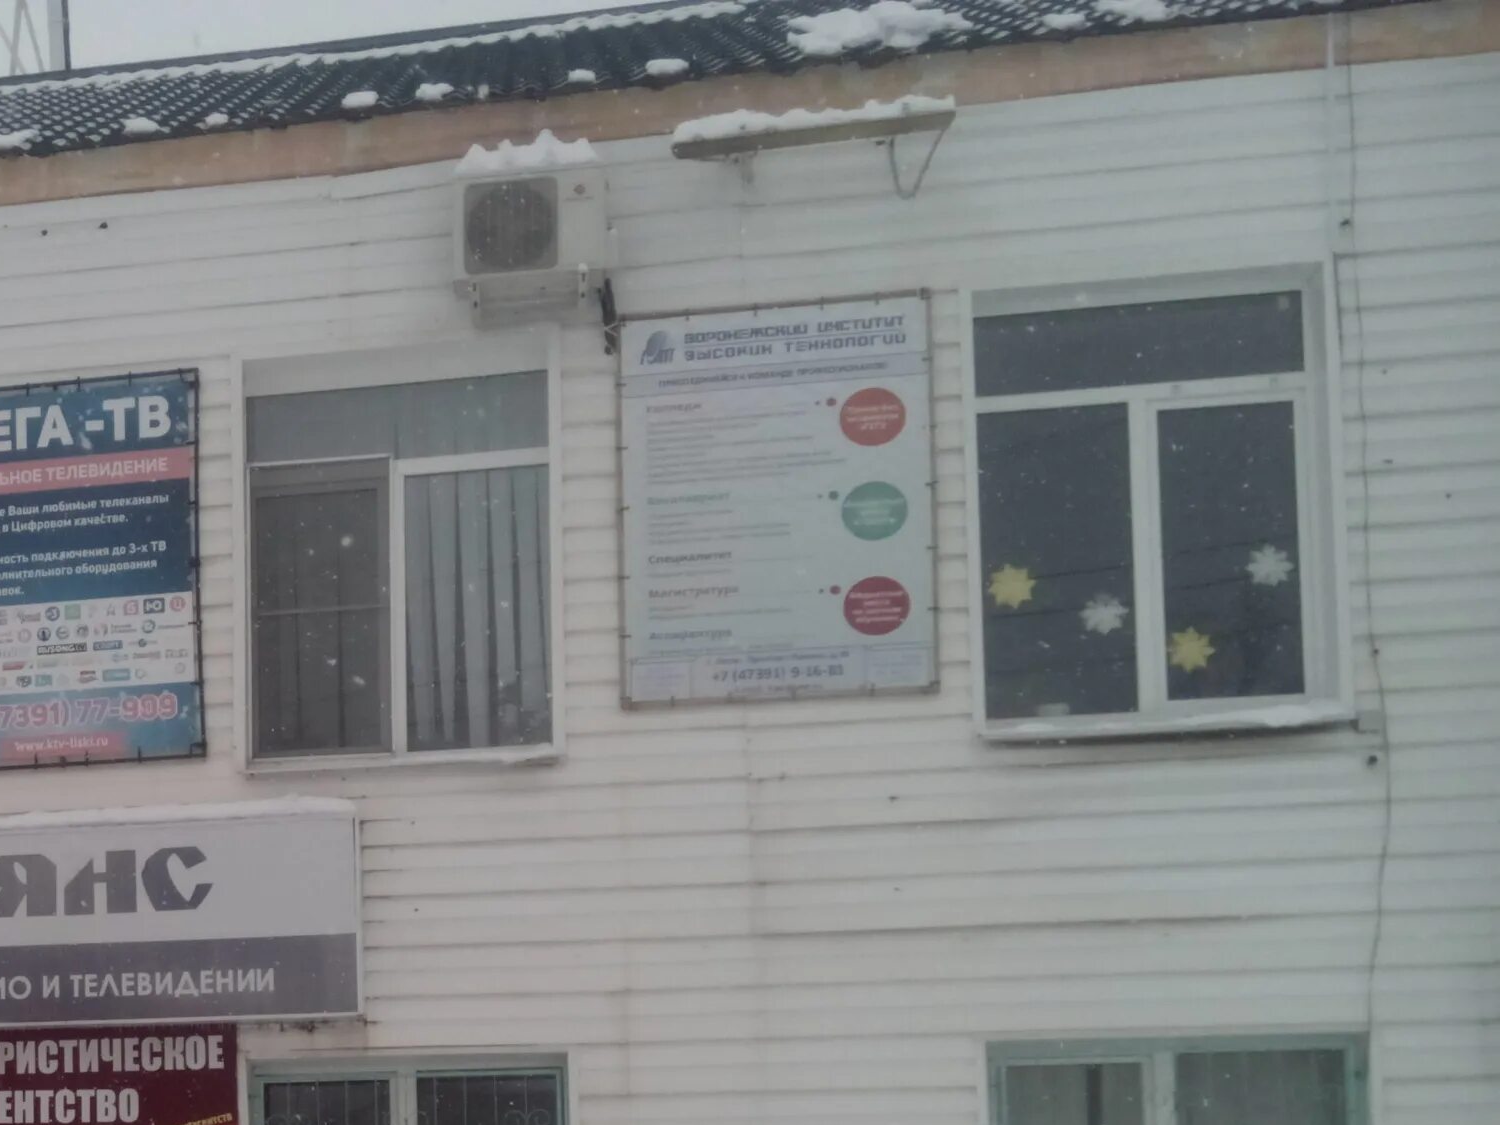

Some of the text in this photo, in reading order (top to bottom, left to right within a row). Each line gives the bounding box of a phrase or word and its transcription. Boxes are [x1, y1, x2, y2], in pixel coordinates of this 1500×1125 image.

[684, 315, 906, 344] ВОРОНЕЖСКИЙ ИНСТИТУТ
[684, 344, 773, 361] ВЫСОКИХ
[785, 333, 906, 353] ТЕХНОЛОГИЙ
[45, 457, 169, 483] ТЕЛЕВИДЕНИЕ
[7, 503, 40, 517] Ваши
[41, 499, 96, 514] любимые
[100, 493, 170, 508] телеканалы
[1, 522, 9, 533] в
[11, 517, 72, 534] Цифровом
[74, 512, 129, 527] качестве.
[31, 548, 110, 562] подключения
[112, 545, 126, 559] до
[128, 542, 148, 554] 3-х
[150, 540, 167, 552] ТВ
[75, 559, 158, 577] оборудования
[41, 974, 61, 999] И
[69, 968, 276, 1000] ТЕЛЕВИДЕНИИ
